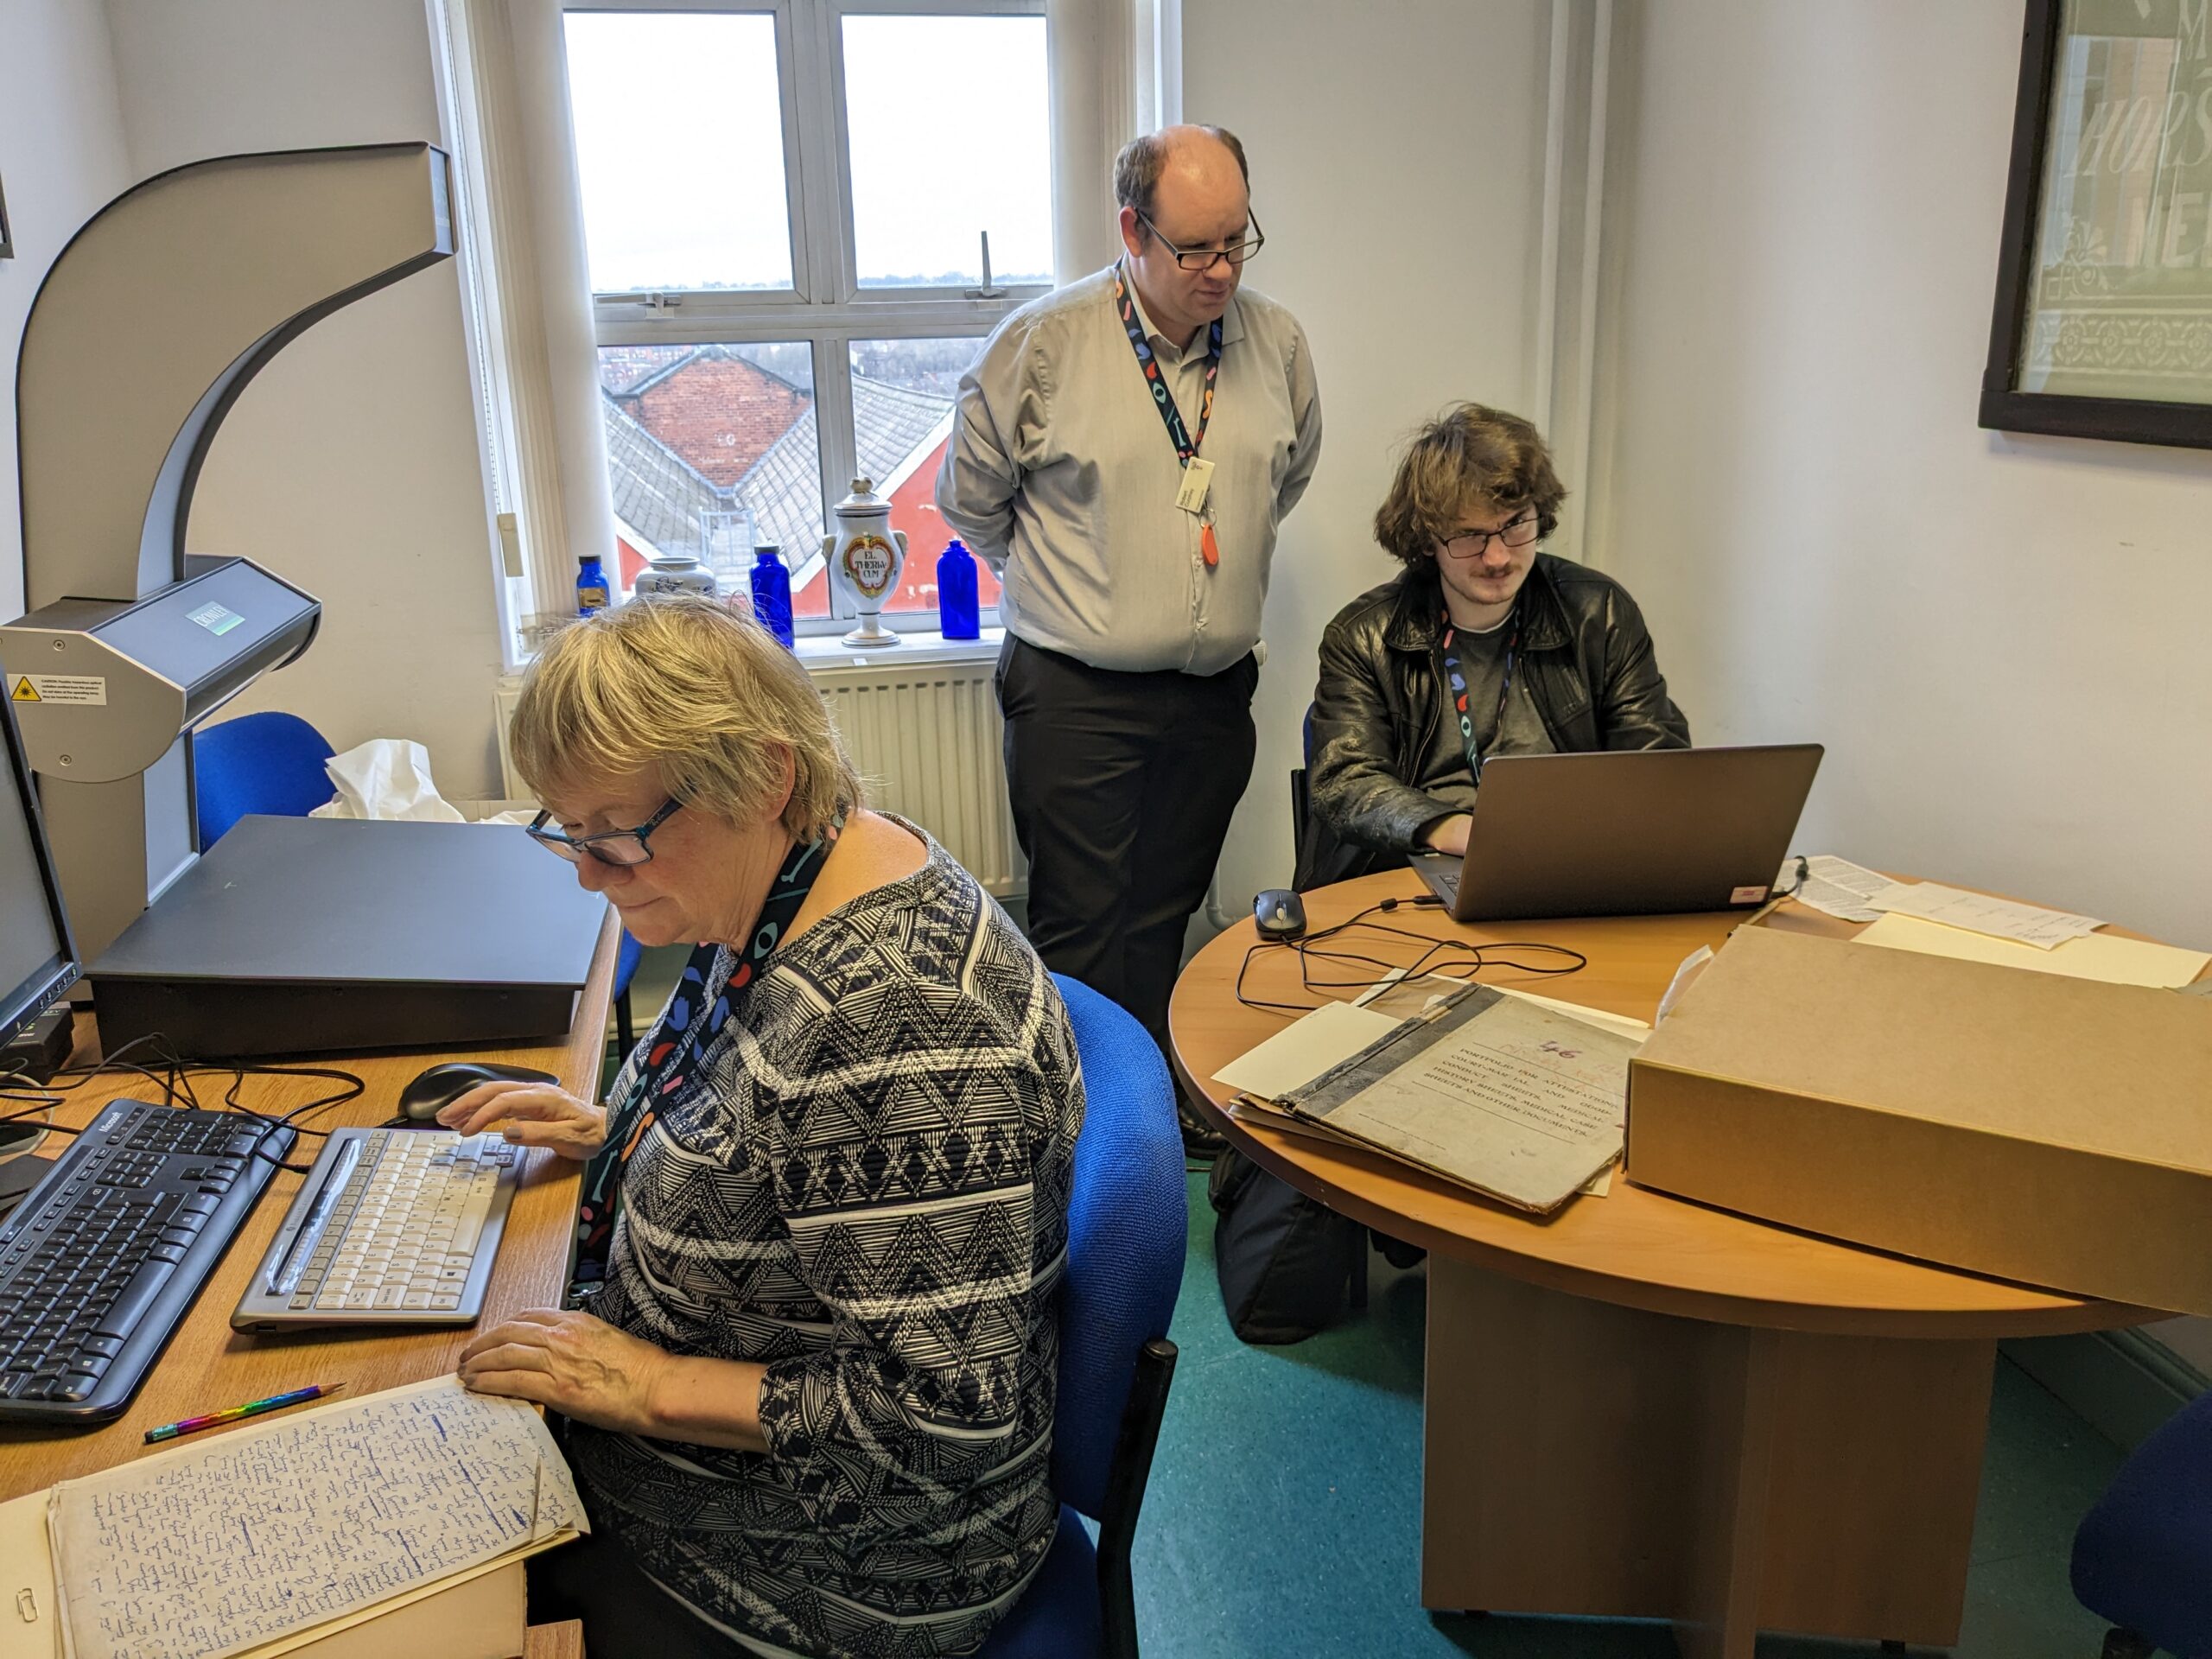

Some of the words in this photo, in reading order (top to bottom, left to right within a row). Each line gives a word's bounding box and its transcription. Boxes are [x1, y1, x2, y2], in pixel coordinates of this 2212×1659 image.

[193, 604, 230, 627] CROWLEY
[1540, 1040, 1583, 1058] 46
[1459, 1048, 1514, 1070] PORTFOLIO
[1517, 1069, 1538, 1079] FOR
[1423, 1073, 1463, 1090] SHEETS
[1463, 1088, 1485, 1098] AND
[1485, 1096, 1522, 1114] OTHER
[1433, 1066, 1474, 1084] HISTORY
[1521, 1100, 1567, 1121] MEDICAL
[1570, 1118, 1599, 1130] CASE
[1442, 1061, 1487, 1079] CONDUCT
[1558, 1104, 1605, 1123] MEDICAL
[1541, 1090, 1565, 1099] AND
[99, 1112, 123, 1132] Microsoft
